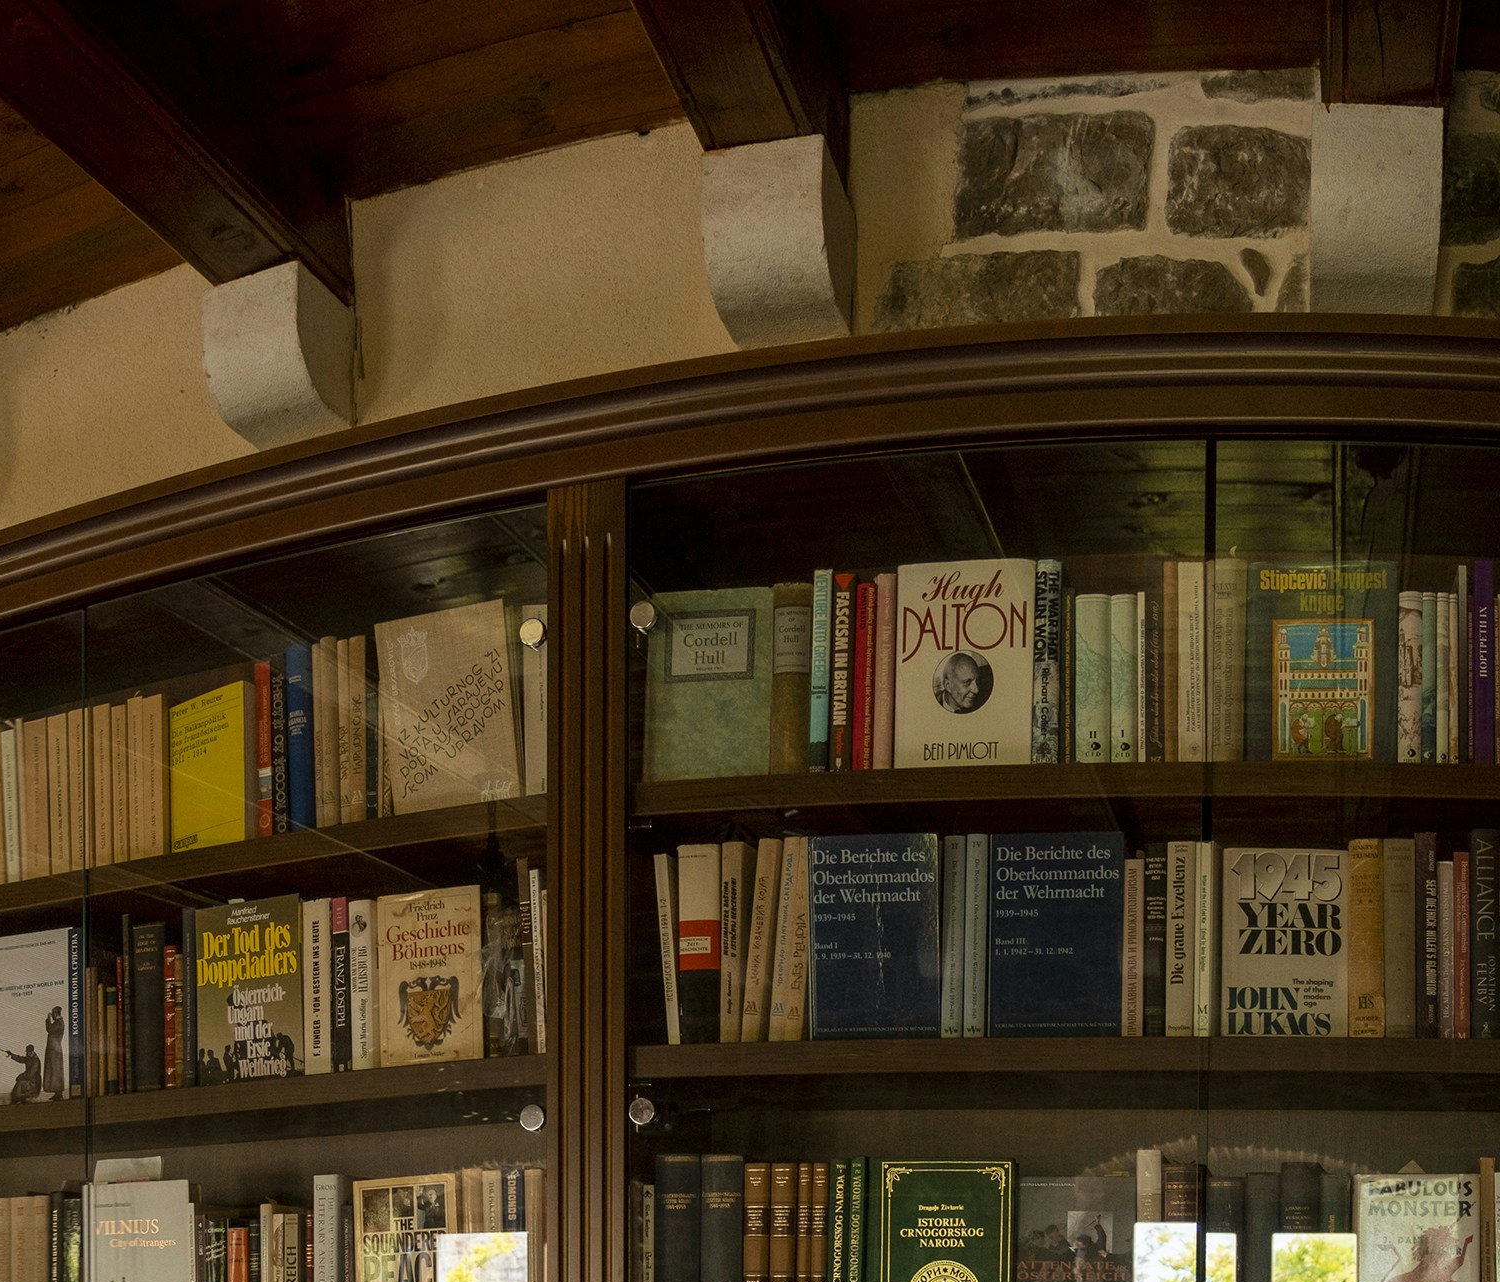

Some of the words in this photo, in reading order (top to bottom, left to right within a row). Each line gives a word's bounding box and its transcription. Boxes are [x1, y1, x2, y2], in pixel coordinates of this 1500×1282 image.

[1048, 571, 1059, 595] THE
[1260, 569, 1327, 590] Stipčević
[1329, 569, 1387, 590] Povijest
[923, 570, 1004, 614] Hugh
[1036, 571, 1047, 619] STALIN
[1299, 593, 1345, 614] knjige
[835, 592, 850, 650] FASCISM
[1048, 599, 1059, 627] WAR
[697, 623, 730, 631] MEMOIRS
[902, 600, 1027, 663] DALTON
[684, 633, 738, 648] Cordell
[1035, 624, 1046, 662] WON
[1048, 631, 1058, 662] THAT
[694, 650, 725, 665] Hull
[835, 653, 848, 667] IN
[1041, 668, 1050, 703] Richard
[171, 707, 188, 718] Peter
[191, 702, 198, 711] W.
[202, 694, 223, 707] Reuter
[398, 729, 410, 745] IZ
[414, 664, 483, 734] KULTURNOG
[833, 670, 847, 726] BRITAIN
[399, 738, 432, 759] VOTA
[432, 725, 442, 735] U
[447, 662, 502, 724] SARAJEVU
[434, 680, 504, 753] AUSTROUGAR
[172, 729, 182, 738] Die
[185, 713, 226, 734] Balkanpolitik
[172, 738, 182, 748] des
[184, 722, 229, 744] französischen
[402, 764, 438, 798] SKOM
[445, 698, 505, 758] UPRAVOM
[924, 742, 945, 760] BEN
[948, 741, 999, 760] PIMLOTT
[814, 849, 834, 865] Die
[841, 849, 899, 864] Berichte
[902, 849, 926, 862] des
[814, 869, 935, 886] Oberkommandos
[1172, 856, 1185, 919] Exzellenz
[1231, 852, 1343, 901] 1945
[814, 890, 836, 904] der
[841, 888, 921, 903] Wehrmacht
[1476, 839, 1495, 940] ALLIANCE
[227, 911, 270, 925] Rauchensteiner
[231, 905, 256, 916] Manfried
[408, 901, 445, 913] Friedrich
[416, 913, 437, 922] Prinz
[1239, 903, 1341, 930] YEAR
[203, 930, 232, 959] Der
[233, 925, 261, 953] Tod
[264, 921, 291, 949] des
[386, 920, 471, 944] Geschichte
[1173, 923, 1186, 960] graue
[1239, 930, 1341, 956] ZERO
[392, 942, 464, 961] Böhmens
[197, 946, 297, 988] Doppeladlers
[1171, 963, 1183, 984] Die
[1307, 978, 1334, 988] shaping
[1477, 963, 1487, 1005] FENBY
[233, 983, 286, 1009] Österreich-
[1227, 987, 1299, 1011] JOHN
[227, 1005, 264, 1025] Ungarn
[1227, 1012, 1332, 1036] LUKACS
[234, 1024, 253, 1041] und
[255, 1021, 273, 1038] der
[247, 1040, 271, 1058] Erste
[239, 1056, 287, 1079] Weltkrieg
[1367, 1180, 1472, 1197] FABULOUS
[1367, 1201, 1472, 1217] MONSTER
[95, 1219, 159, 1235] VILNIUS
[394, 1218, 413, 1230] THE
[900, 1227, 984, 1238] CRNOGORSKOG
[917, 1218, 966, 1229] ISTORIJA
[139, 1238, 176, 1248] Strangers
[919, 1238, 965, 1248] NARODA
